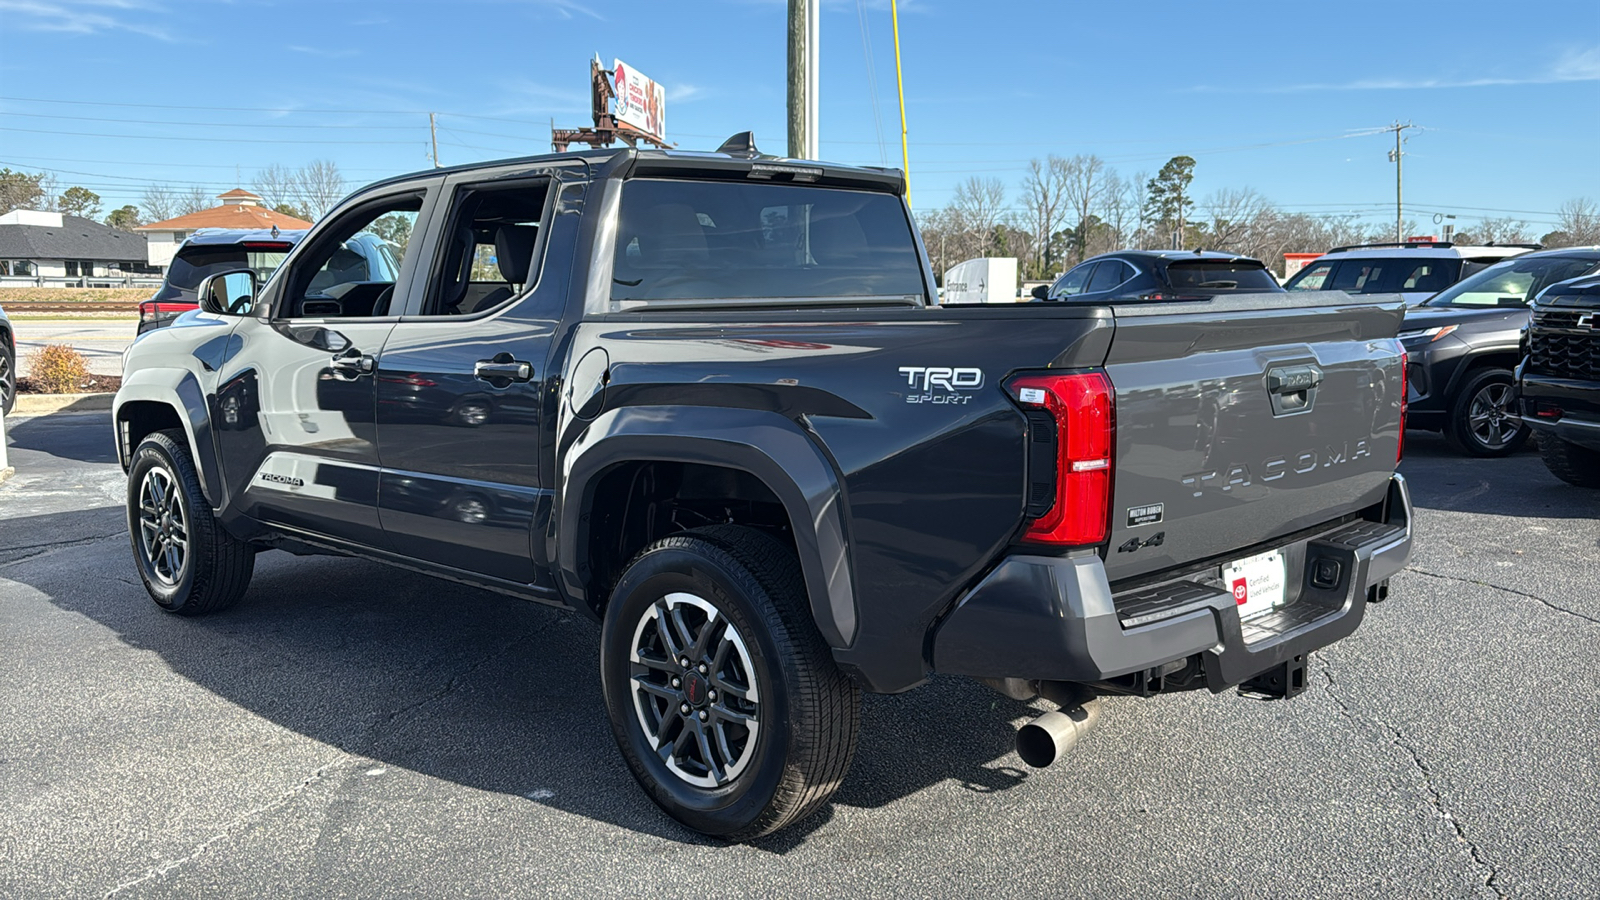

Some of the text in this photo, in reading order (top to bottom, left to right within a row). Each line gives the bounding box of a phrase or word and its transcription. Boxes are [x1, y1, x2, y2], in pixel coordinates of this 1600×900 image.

[946, 279, 968, 293] Entrance
[898, 366, 983, 392] TRD
[906, 394, 973, 405] SPORT
[1182, 436, 1371, 497] TACOMA
[260, 471, 303, 487] TACOMA
[1249, 573, 1270, 588] Certified
[1249, 582, 1280, 598] Used Vehicles
